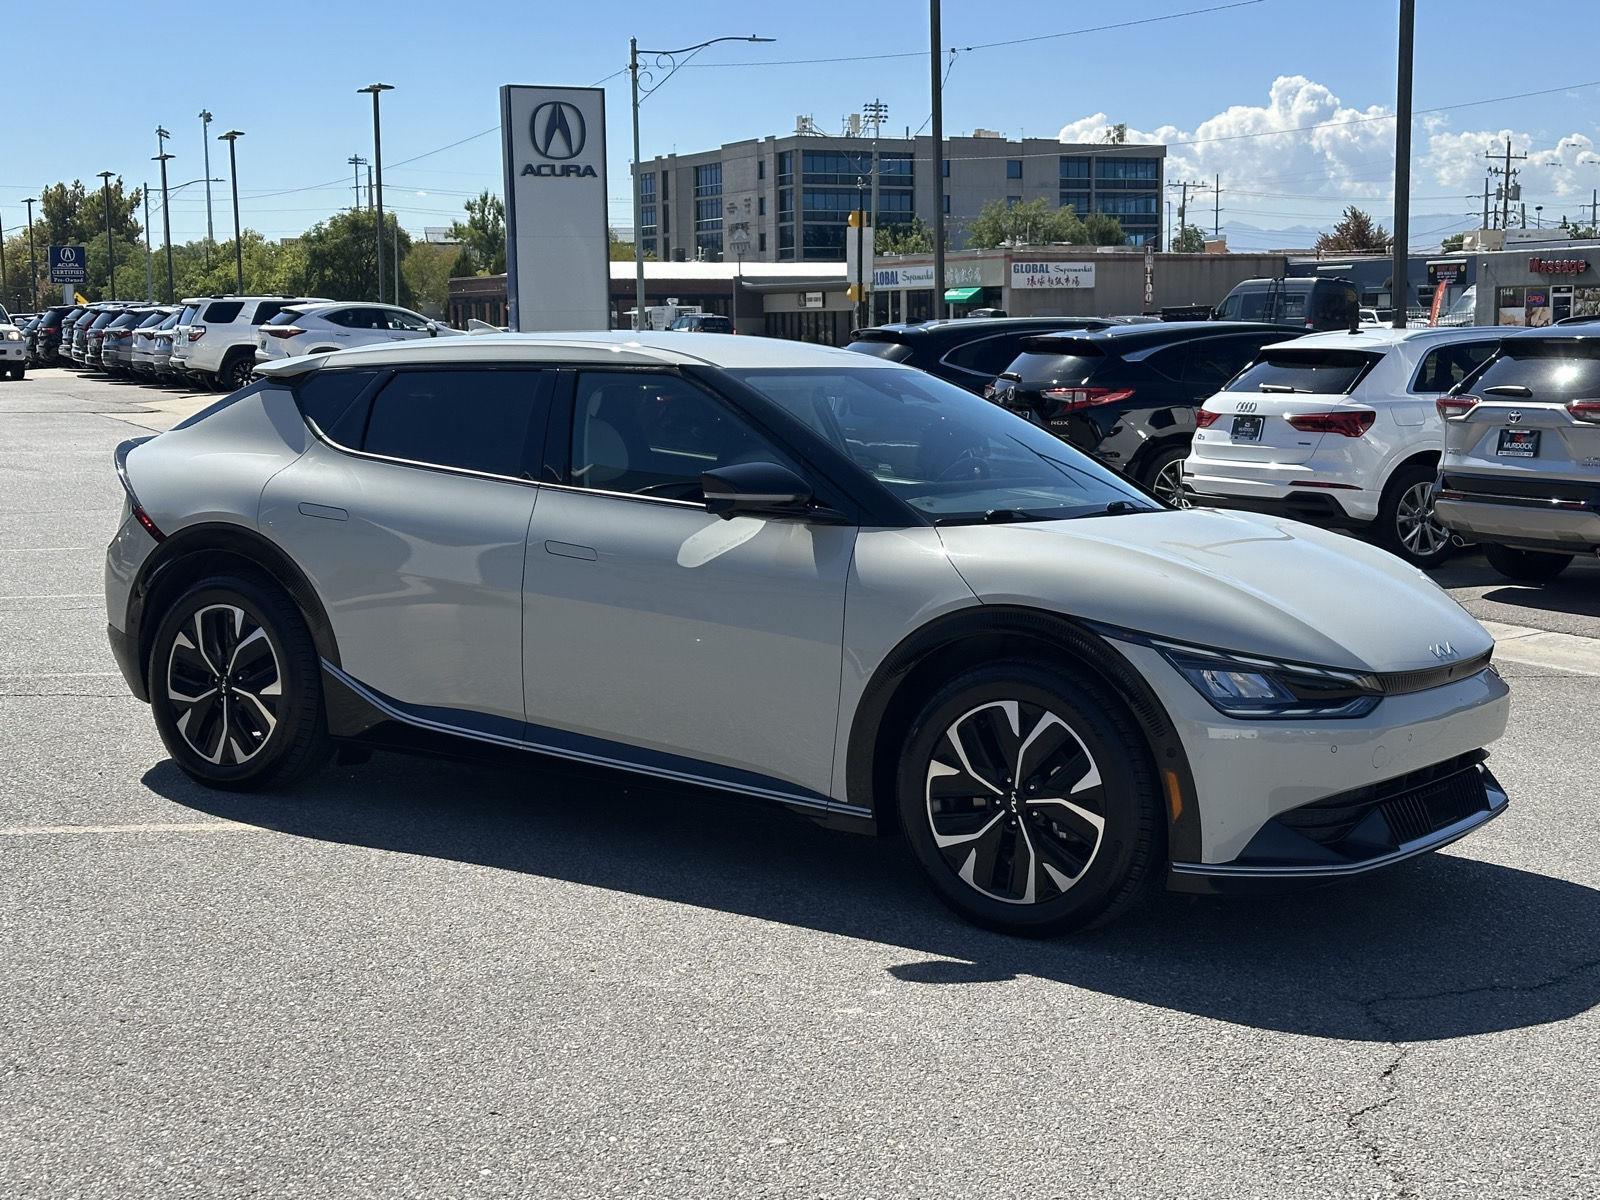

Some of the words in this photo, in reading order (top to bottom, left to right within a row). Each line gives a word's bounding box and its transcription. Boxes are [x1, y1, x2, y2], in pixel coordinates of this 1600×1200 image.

[521, 163, 598, 178] ACURA
[1013, 263, 1050, 274] GLOBAL
[1053, 264, 1093, 275] Supermarket
[1529, 257, 1586, 276] Massage
[901, 268, 934, 284] Supermarket
[1144, 245, 1154, 302] TATTOO
[1500, 288, 1514, 296] 1144
[1527, 295, 1546, 303] OPEN
[1503, 442, 1533, 450] MURDOCK
